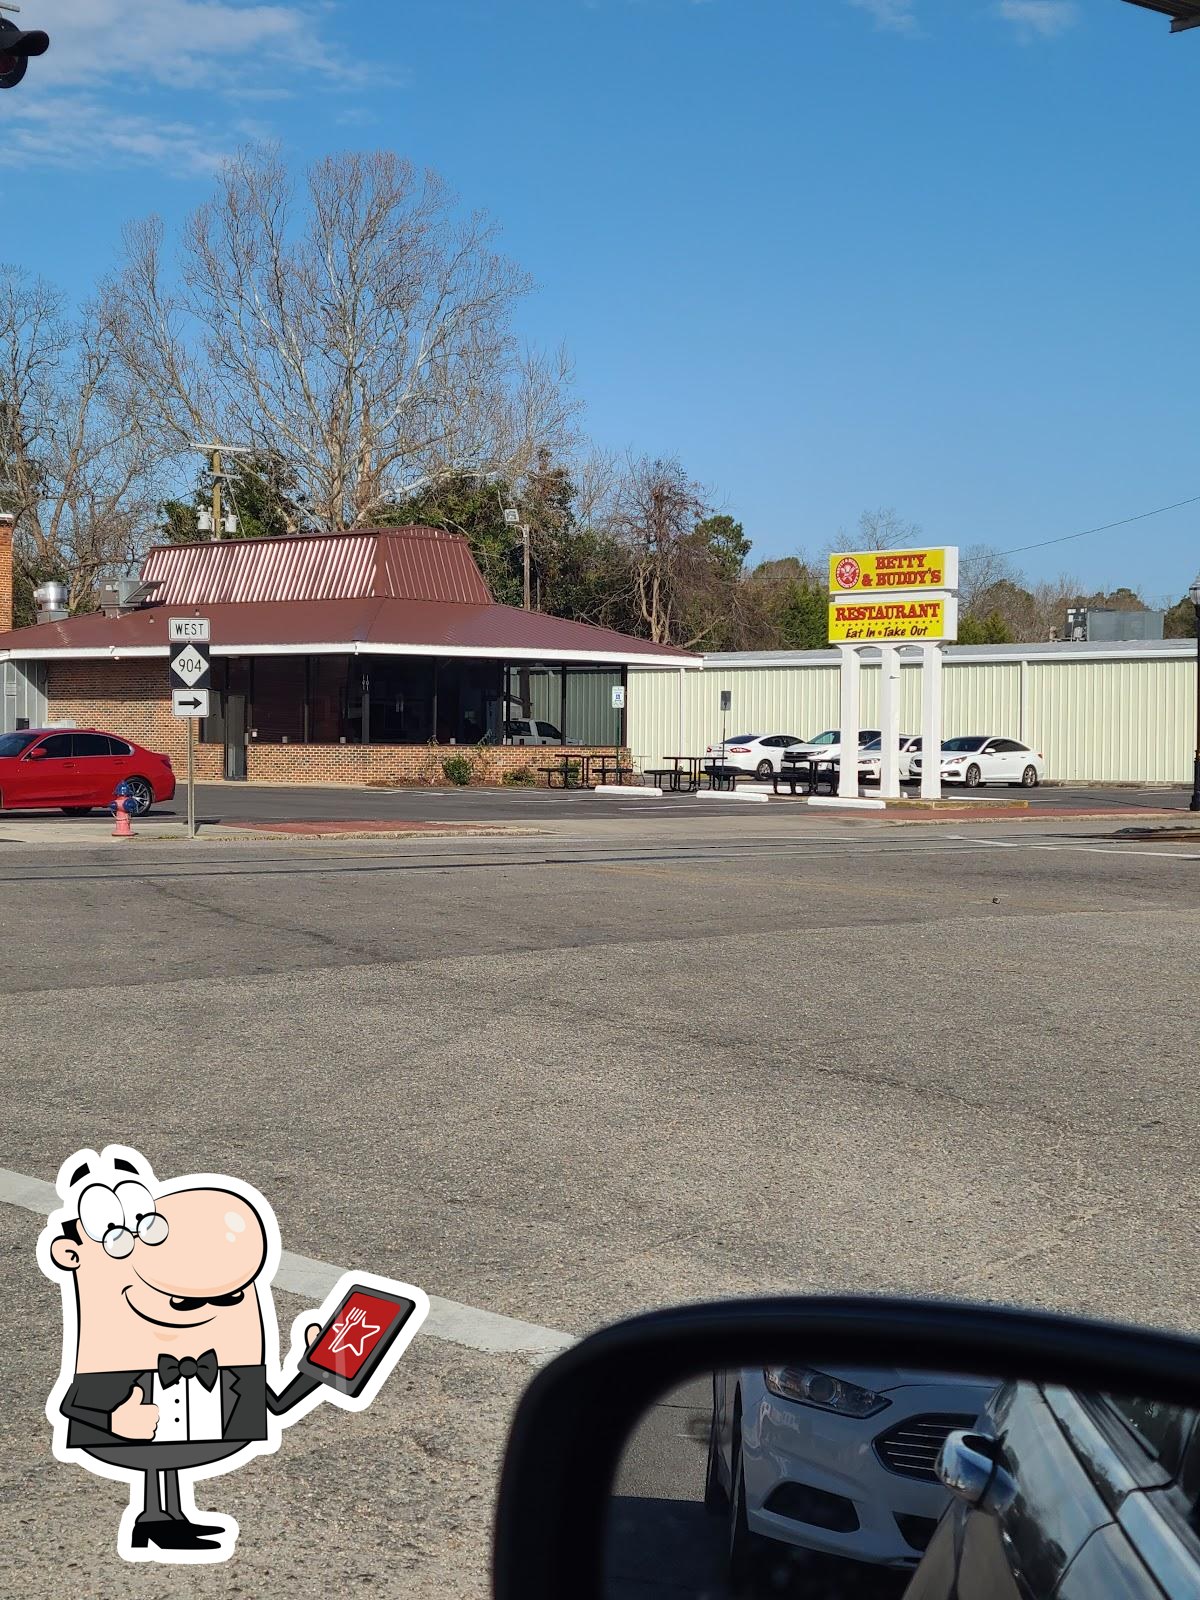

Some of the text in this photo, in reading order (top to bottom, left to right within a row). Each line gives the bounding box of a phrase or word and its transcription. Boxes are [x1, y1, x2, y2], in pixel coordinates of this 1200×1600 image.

[875, 554, 926, 570] BETTY
[862, 573, 872, 586] &
[876, 568, 941, 586] BUDDY'S
[835, 603, 940, 621] RESTAURANT
[175, 623, 204, 636] WEST
[845, 625, 928, 638] Eat In Take Out
[178, 658, 202, 673] 904
